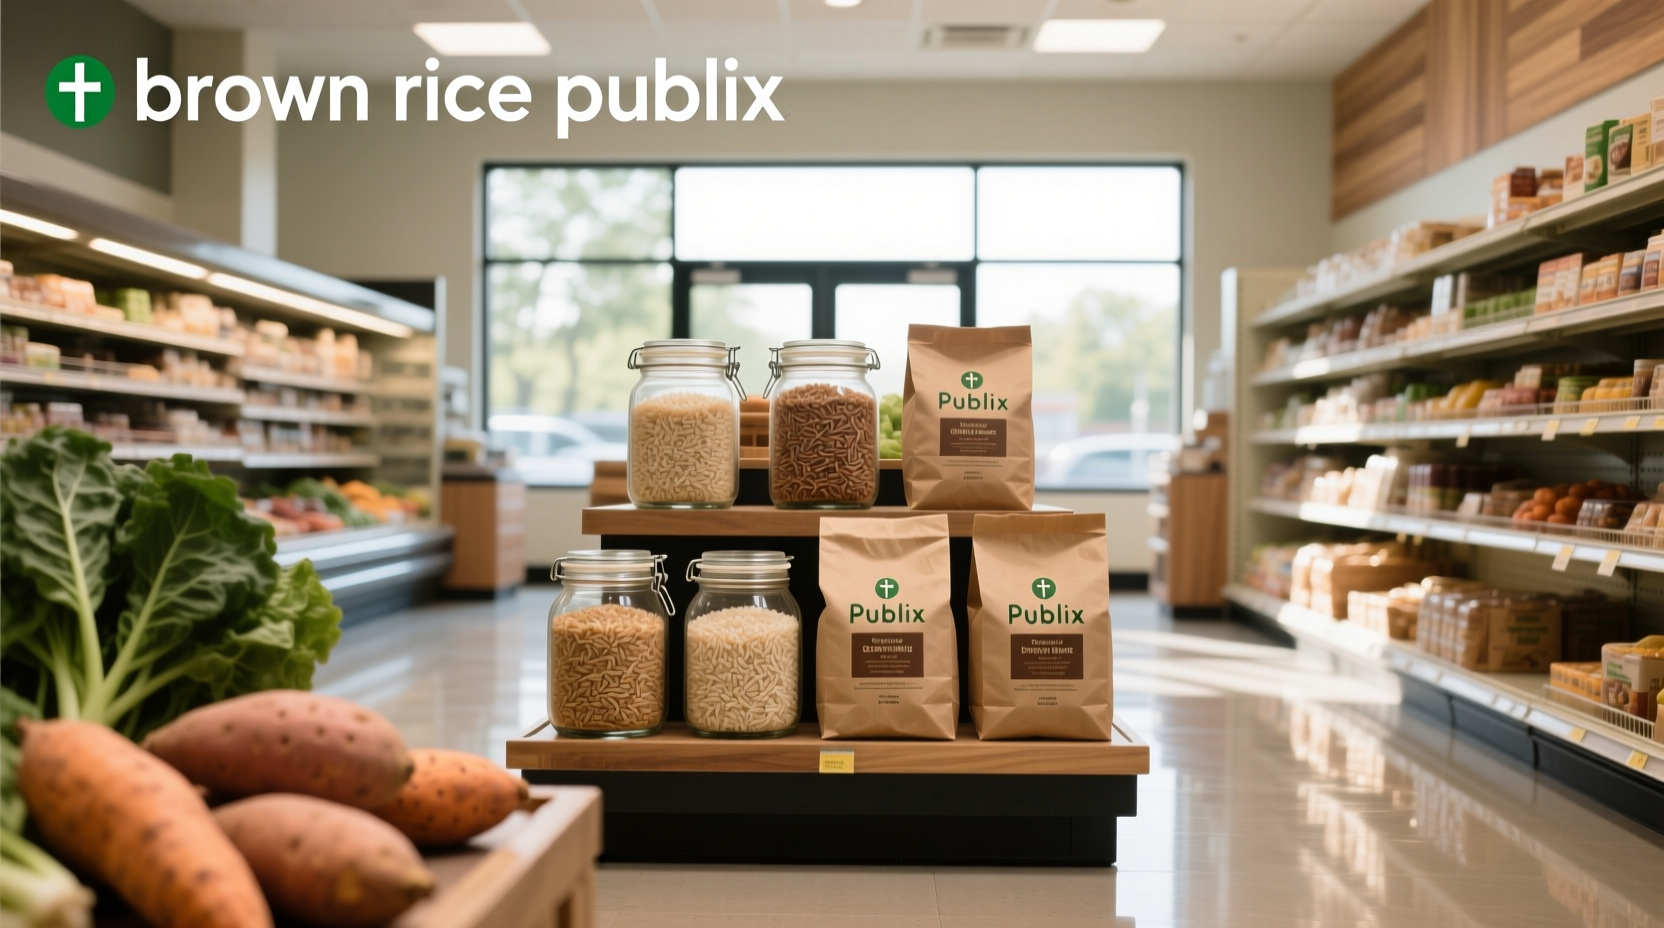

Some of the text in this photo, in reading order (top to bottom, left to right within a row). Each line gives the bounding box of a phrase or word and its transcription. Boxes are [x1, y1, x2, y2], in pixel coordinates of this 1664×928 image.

[938, 392, 1008, 410] Publix
[849, 603, 925, 624] Publix
[1008, 604, 1085, 625] Publix
